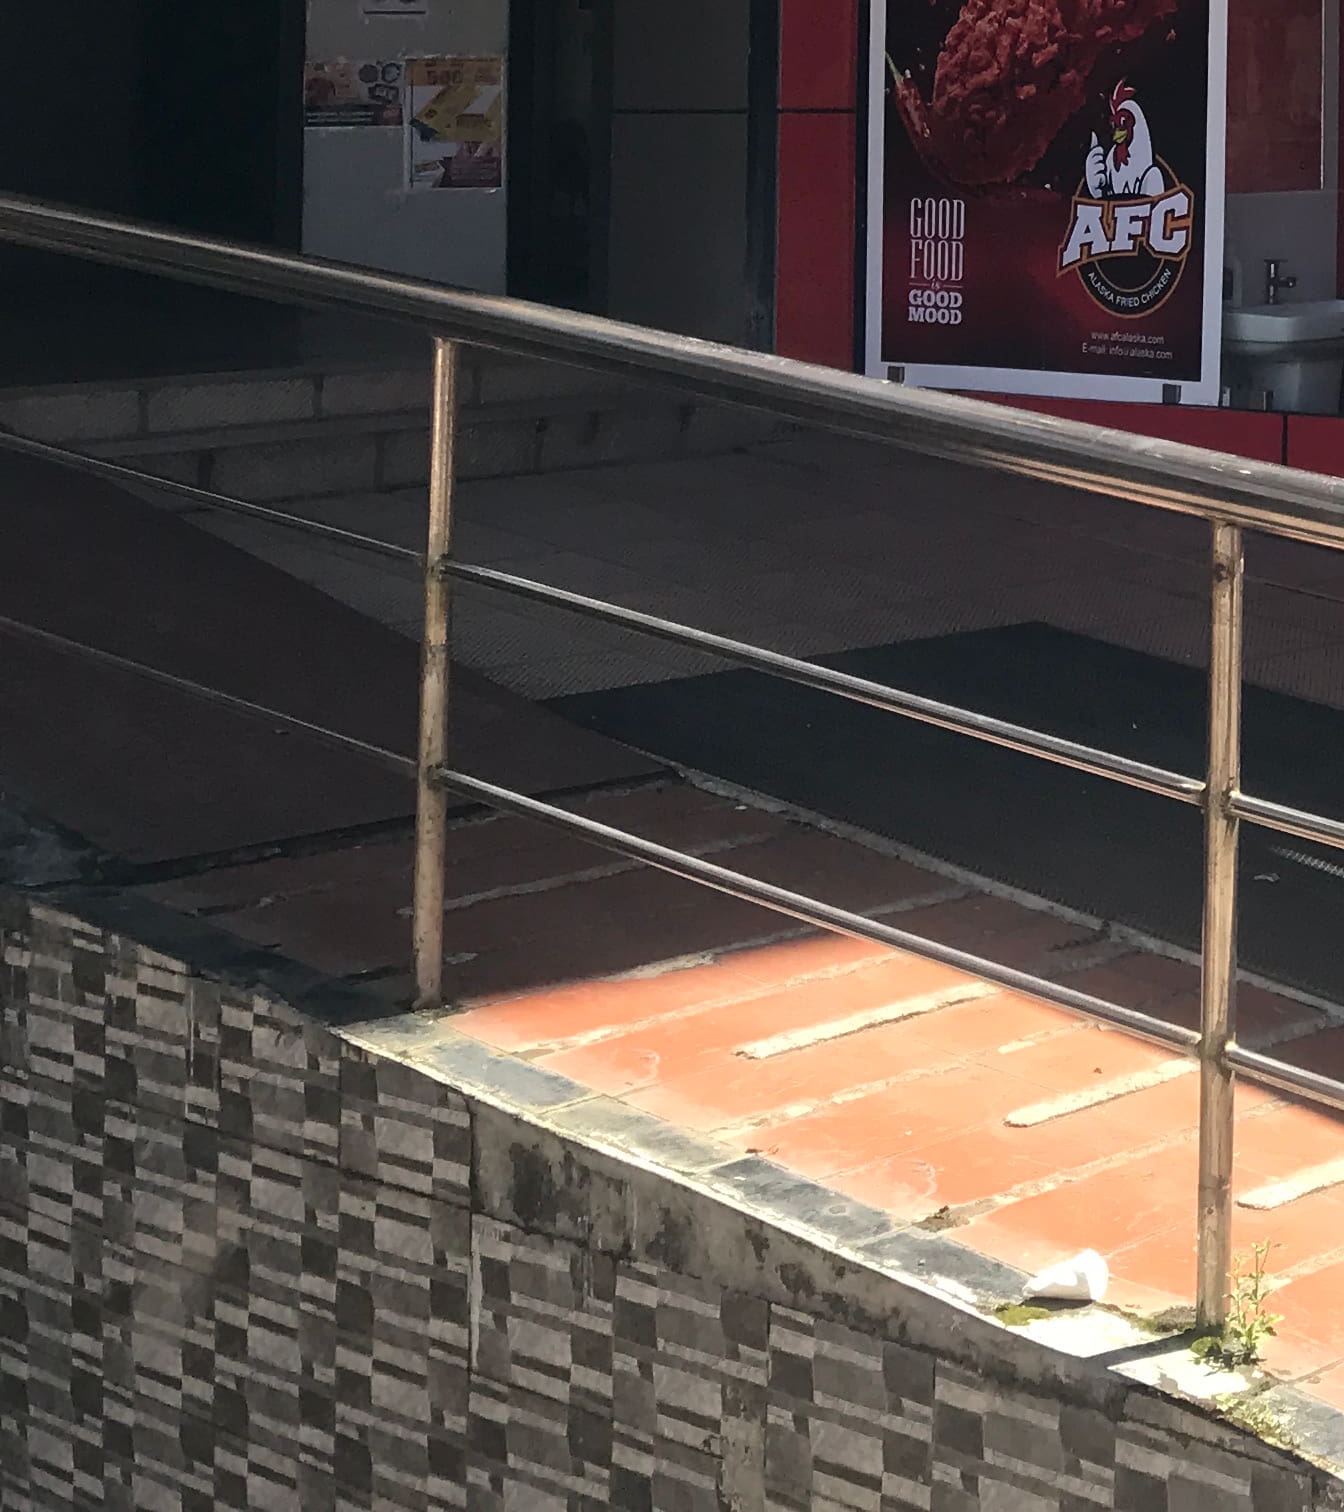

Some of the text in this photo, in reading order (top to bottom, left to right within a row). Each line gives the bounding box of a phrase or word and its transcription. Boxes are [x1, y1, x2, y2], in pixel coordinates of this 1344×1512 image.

[910, 197, 965, 240] GOOD
[1063, 191, 1189, 267] AFC
[910, 239, 964, 281] FOOD
[908, 289, 963, 308] GOOD
[1088, 269, 1172, 308] ALASKA FRIED CHICKEN
[908, 306, 962, 325] MOOD
